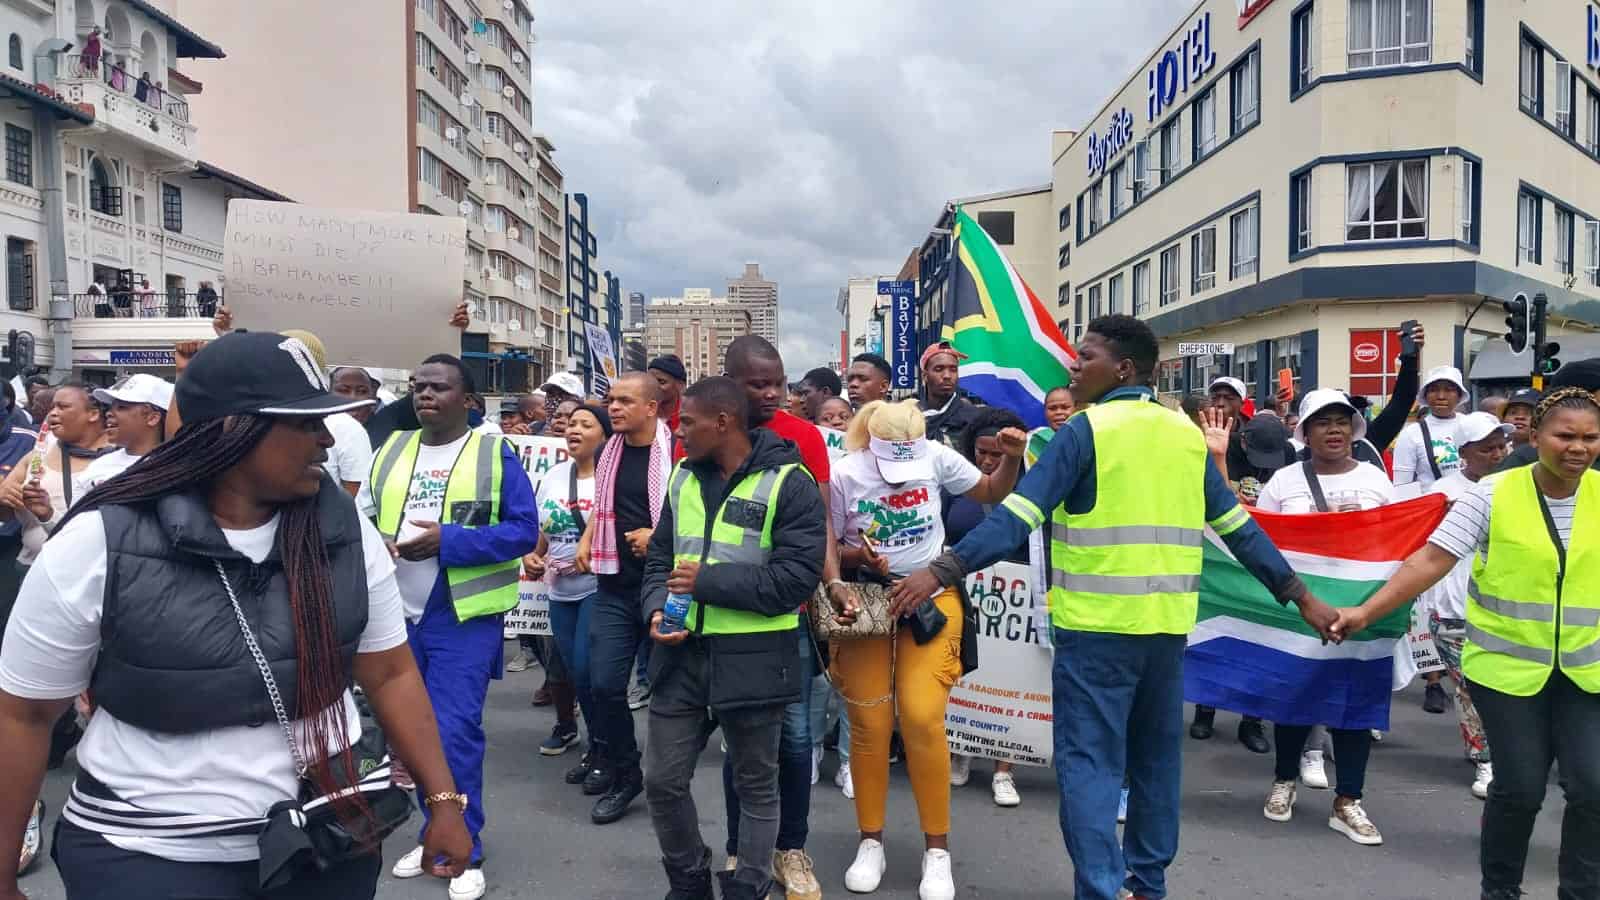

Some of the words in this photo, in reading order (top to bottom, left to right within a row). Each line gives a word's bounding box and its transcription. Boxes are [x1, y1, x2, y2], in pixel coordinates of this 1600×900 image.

[1087, 107, 1133, 178] Bayside
[1146, 11, 1217, 124] HOTEL
[897, 296, 911, 387] Bayside
[1180, 343, 1225, 353] SHEPSTONE
[986, 599, 999, 612] IN
[530, 621, 548, 631] AND
[948, 695, 1003, 715] IMMIGRATION
[1006, 709, 1015, 717] IS
[1017, 710, 1024, 718] A
[950, 714, 966, 725] OUR
[969, 719, 1009, 735] COUNTRY
[945, 728, 954, 738] IN
[957, 731, 996, 747] FIGHTING
[998, 739, 1034, 754] ILLEGAL
[964, 744, 981, 754] AND
[985, 748, 1010, 760] THEIR
